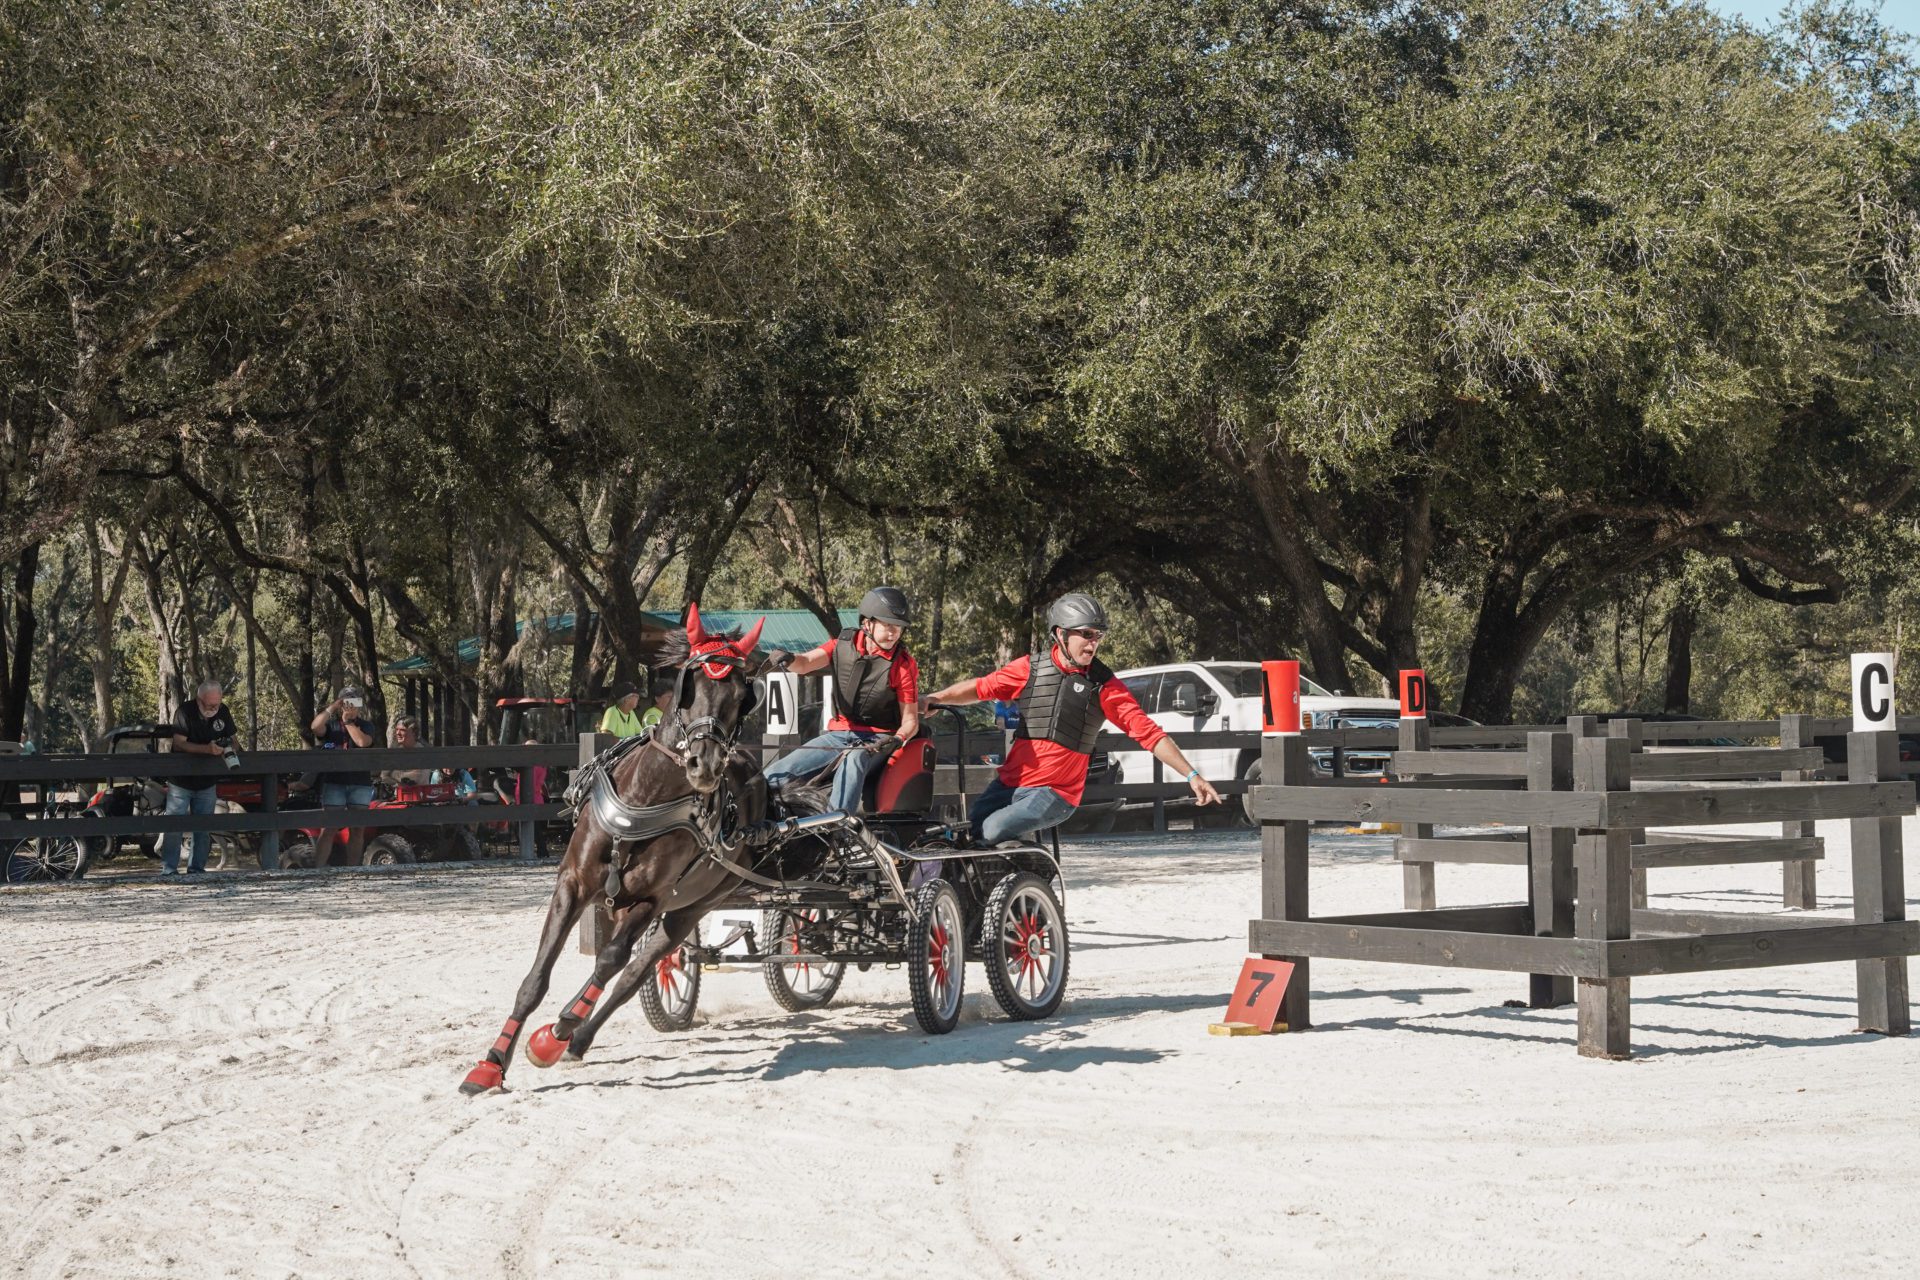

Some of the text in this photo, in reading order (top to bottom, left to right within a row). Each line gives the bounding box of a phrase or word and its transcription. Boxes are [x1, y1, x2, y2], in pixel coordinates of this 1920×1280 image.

[767, 680, 787, 725] A
[1407, 676, 1425, 712] D
[1860, 662, 1890, 722] C
[1245, 970, 1275, 1008] 7
